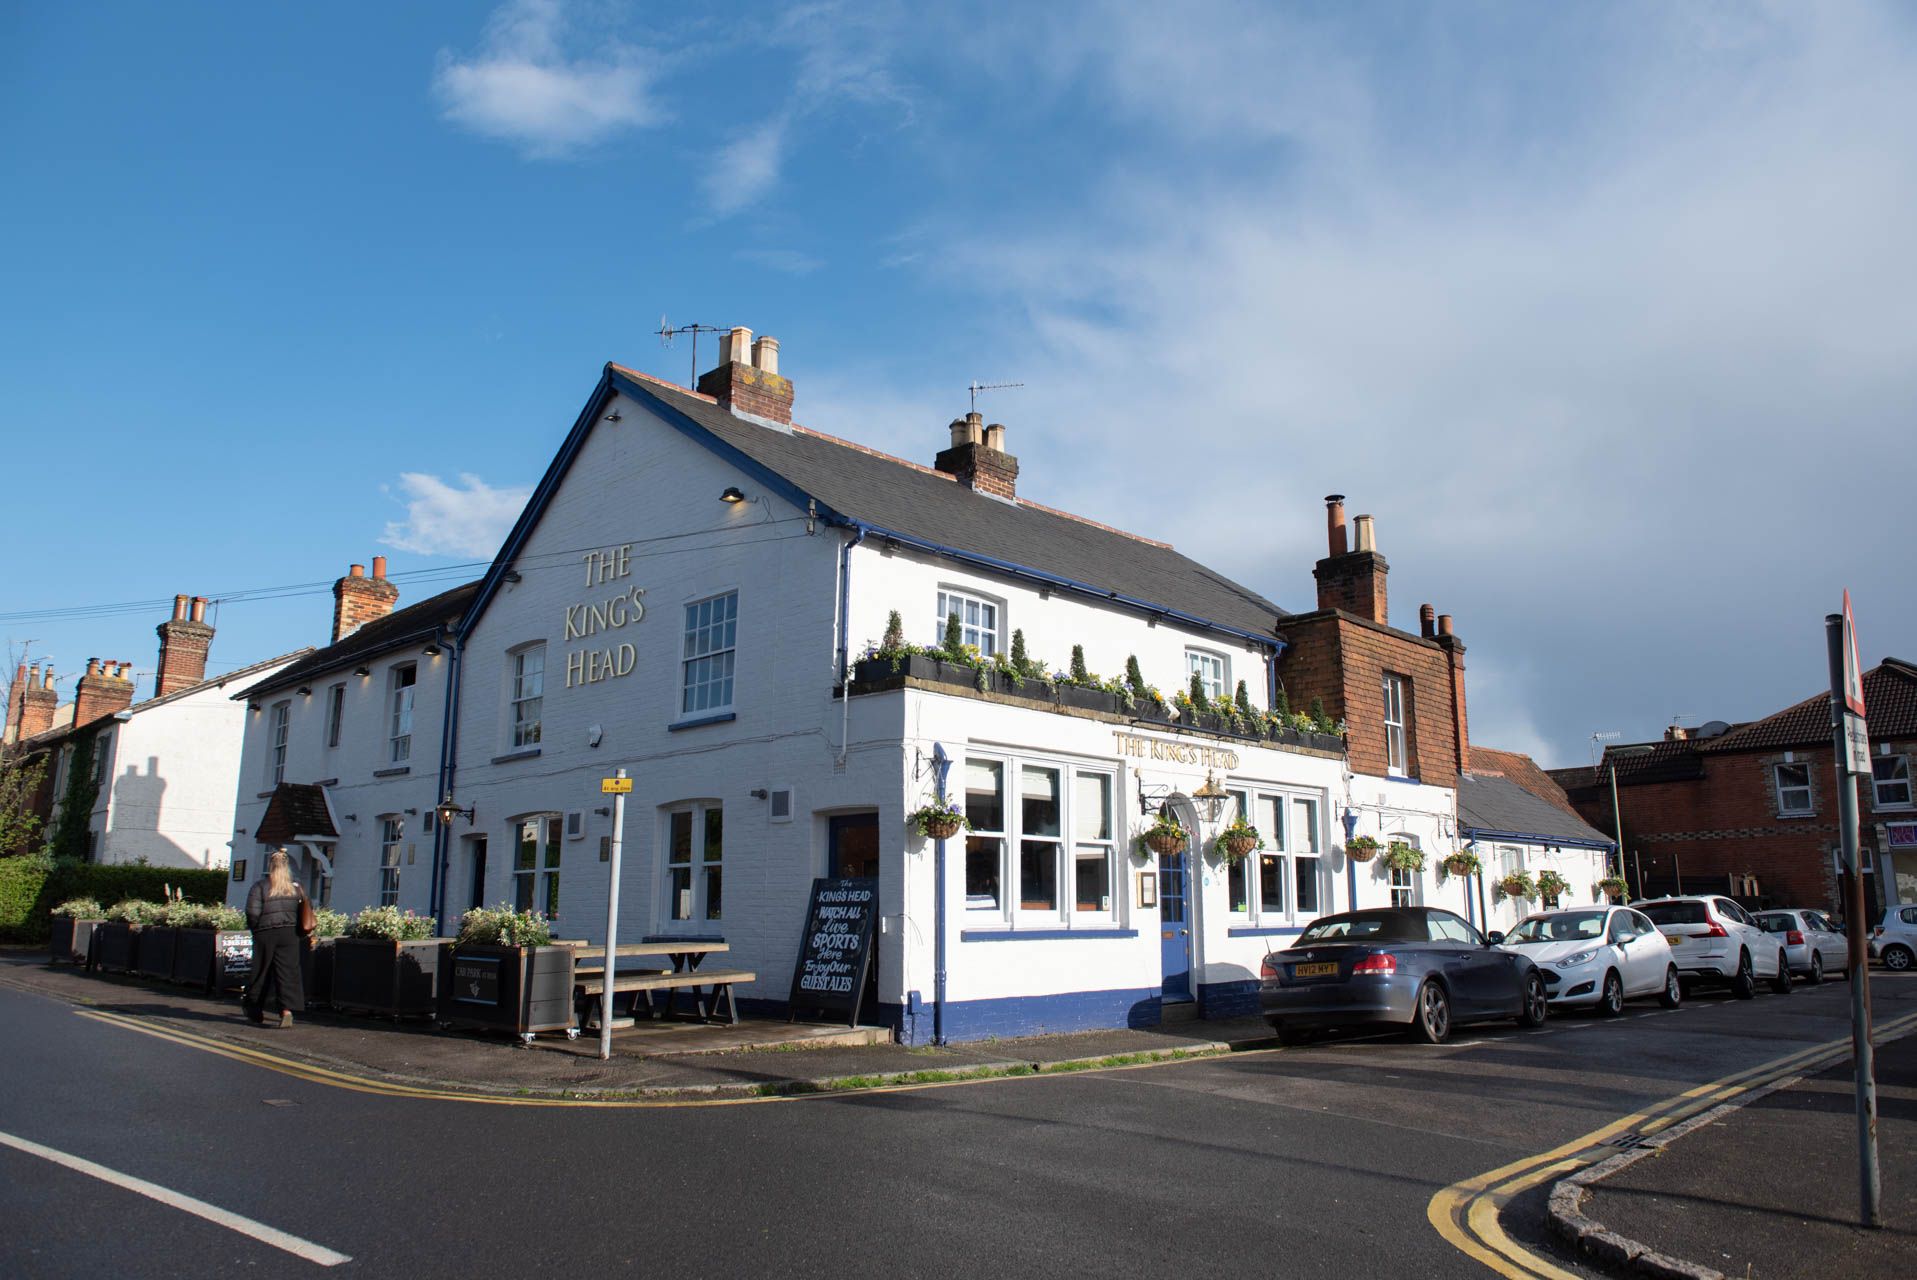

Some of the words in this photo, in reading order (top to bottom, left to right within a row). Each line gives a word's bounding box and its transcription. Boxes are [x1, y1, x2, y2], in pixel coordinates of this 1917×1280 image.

[583, 544, 631, 587] THE
[564, 585, 646, 641] KING'S
[566, 643, 636, 688] HEAD
[1116, 732, 1147, 758] THE
[1151, 738, 1198, 764] KING'S
[1201, 747, 1240, 770] HEAD
[847, 890, 871, 902] HEAD
[818, 906, 847, 919] WATCH
[846, 907, 861, 919] ALL
[813, 933, 859, 949] SPORTS
[817, 947, 842, 960] Here
[805, 960, 830, 977] Enjoy
[829, 961, 851, 974] Our
[800, 975, 830, 990] GUEST
[829, 976, 853, 992] ALES
